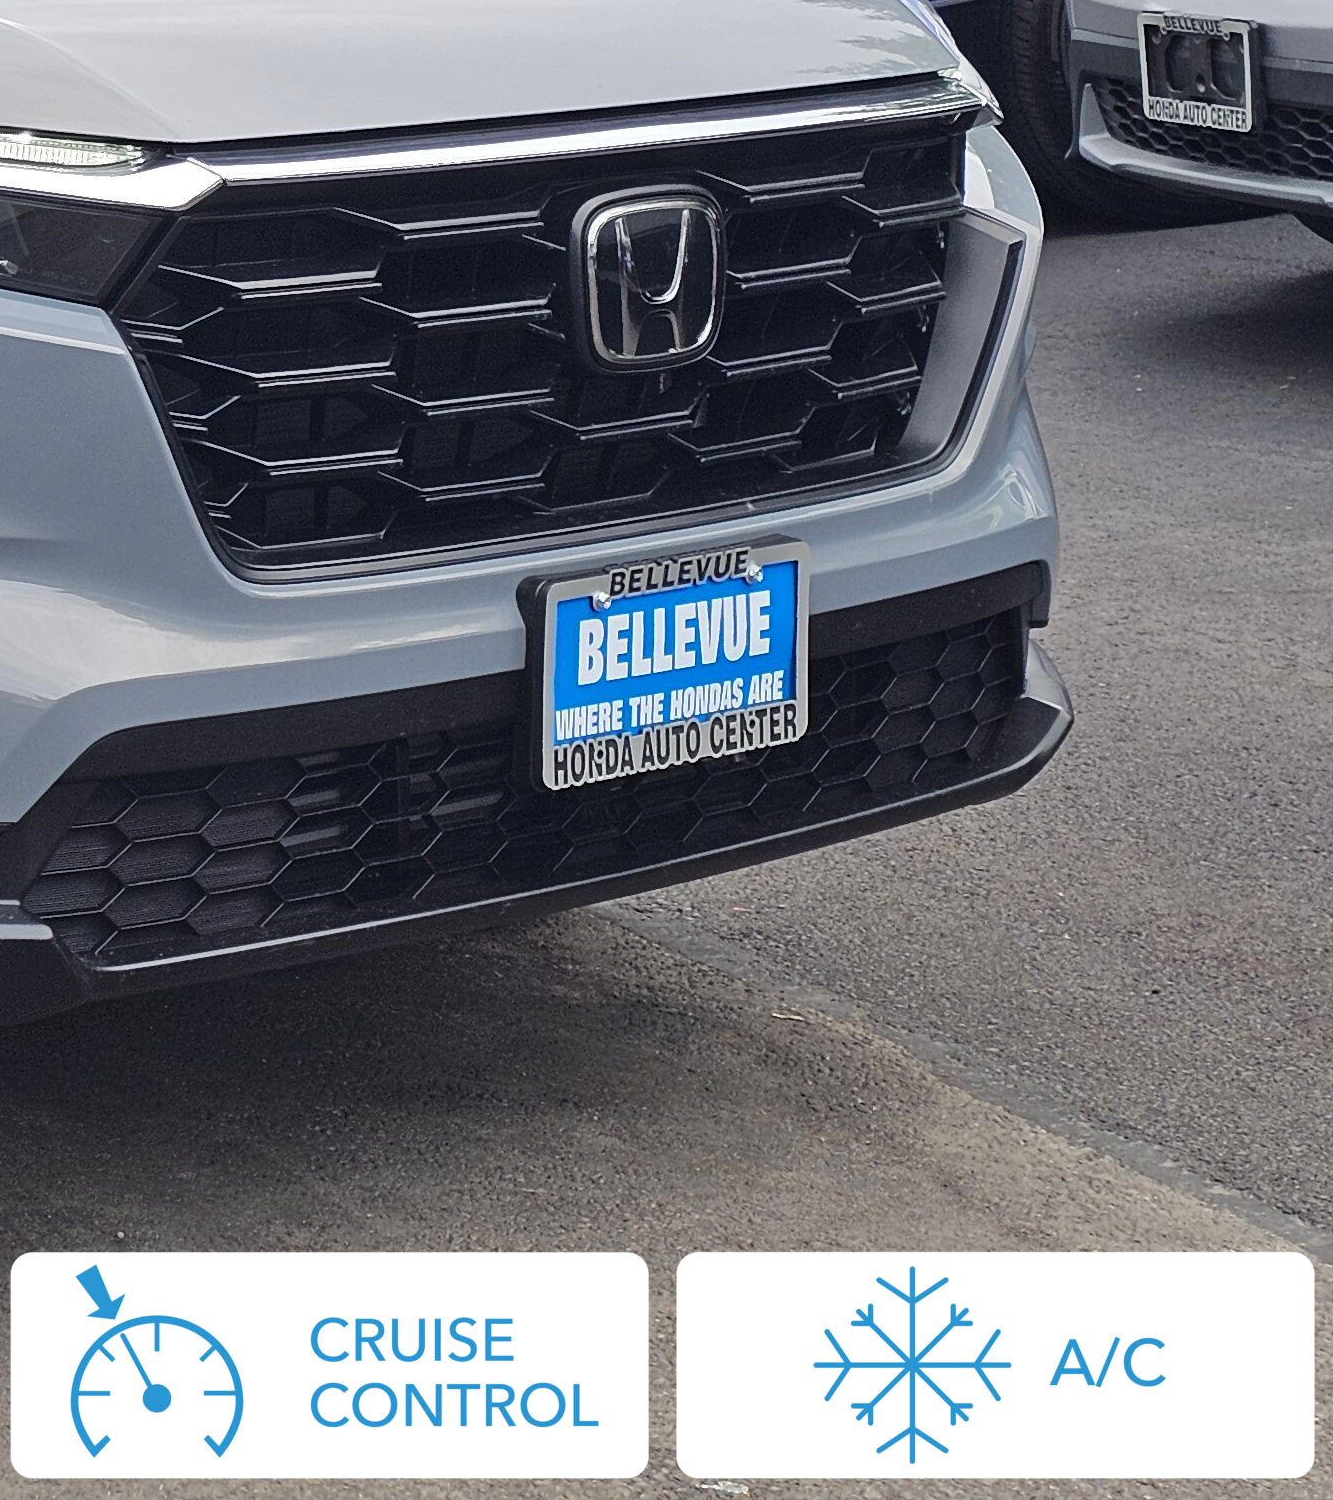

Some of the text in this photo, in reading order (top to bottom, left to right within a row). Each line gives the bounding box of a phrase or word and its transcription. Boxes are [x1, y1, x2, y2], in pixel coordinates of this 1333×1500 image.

[1163, 16, 1222, 33] BELLEVUE
[1148, 99, 1248, 130] HONDA AUTO CENTER
[608, 548, 750, 597] BELLEVUE
[577, 590, 771, 686] BELLEVUE
[555, 669, 785, 741] WHERE THE HONDAS ARE
[553, 702, 797, 787] HONDA AUTO CENTER
